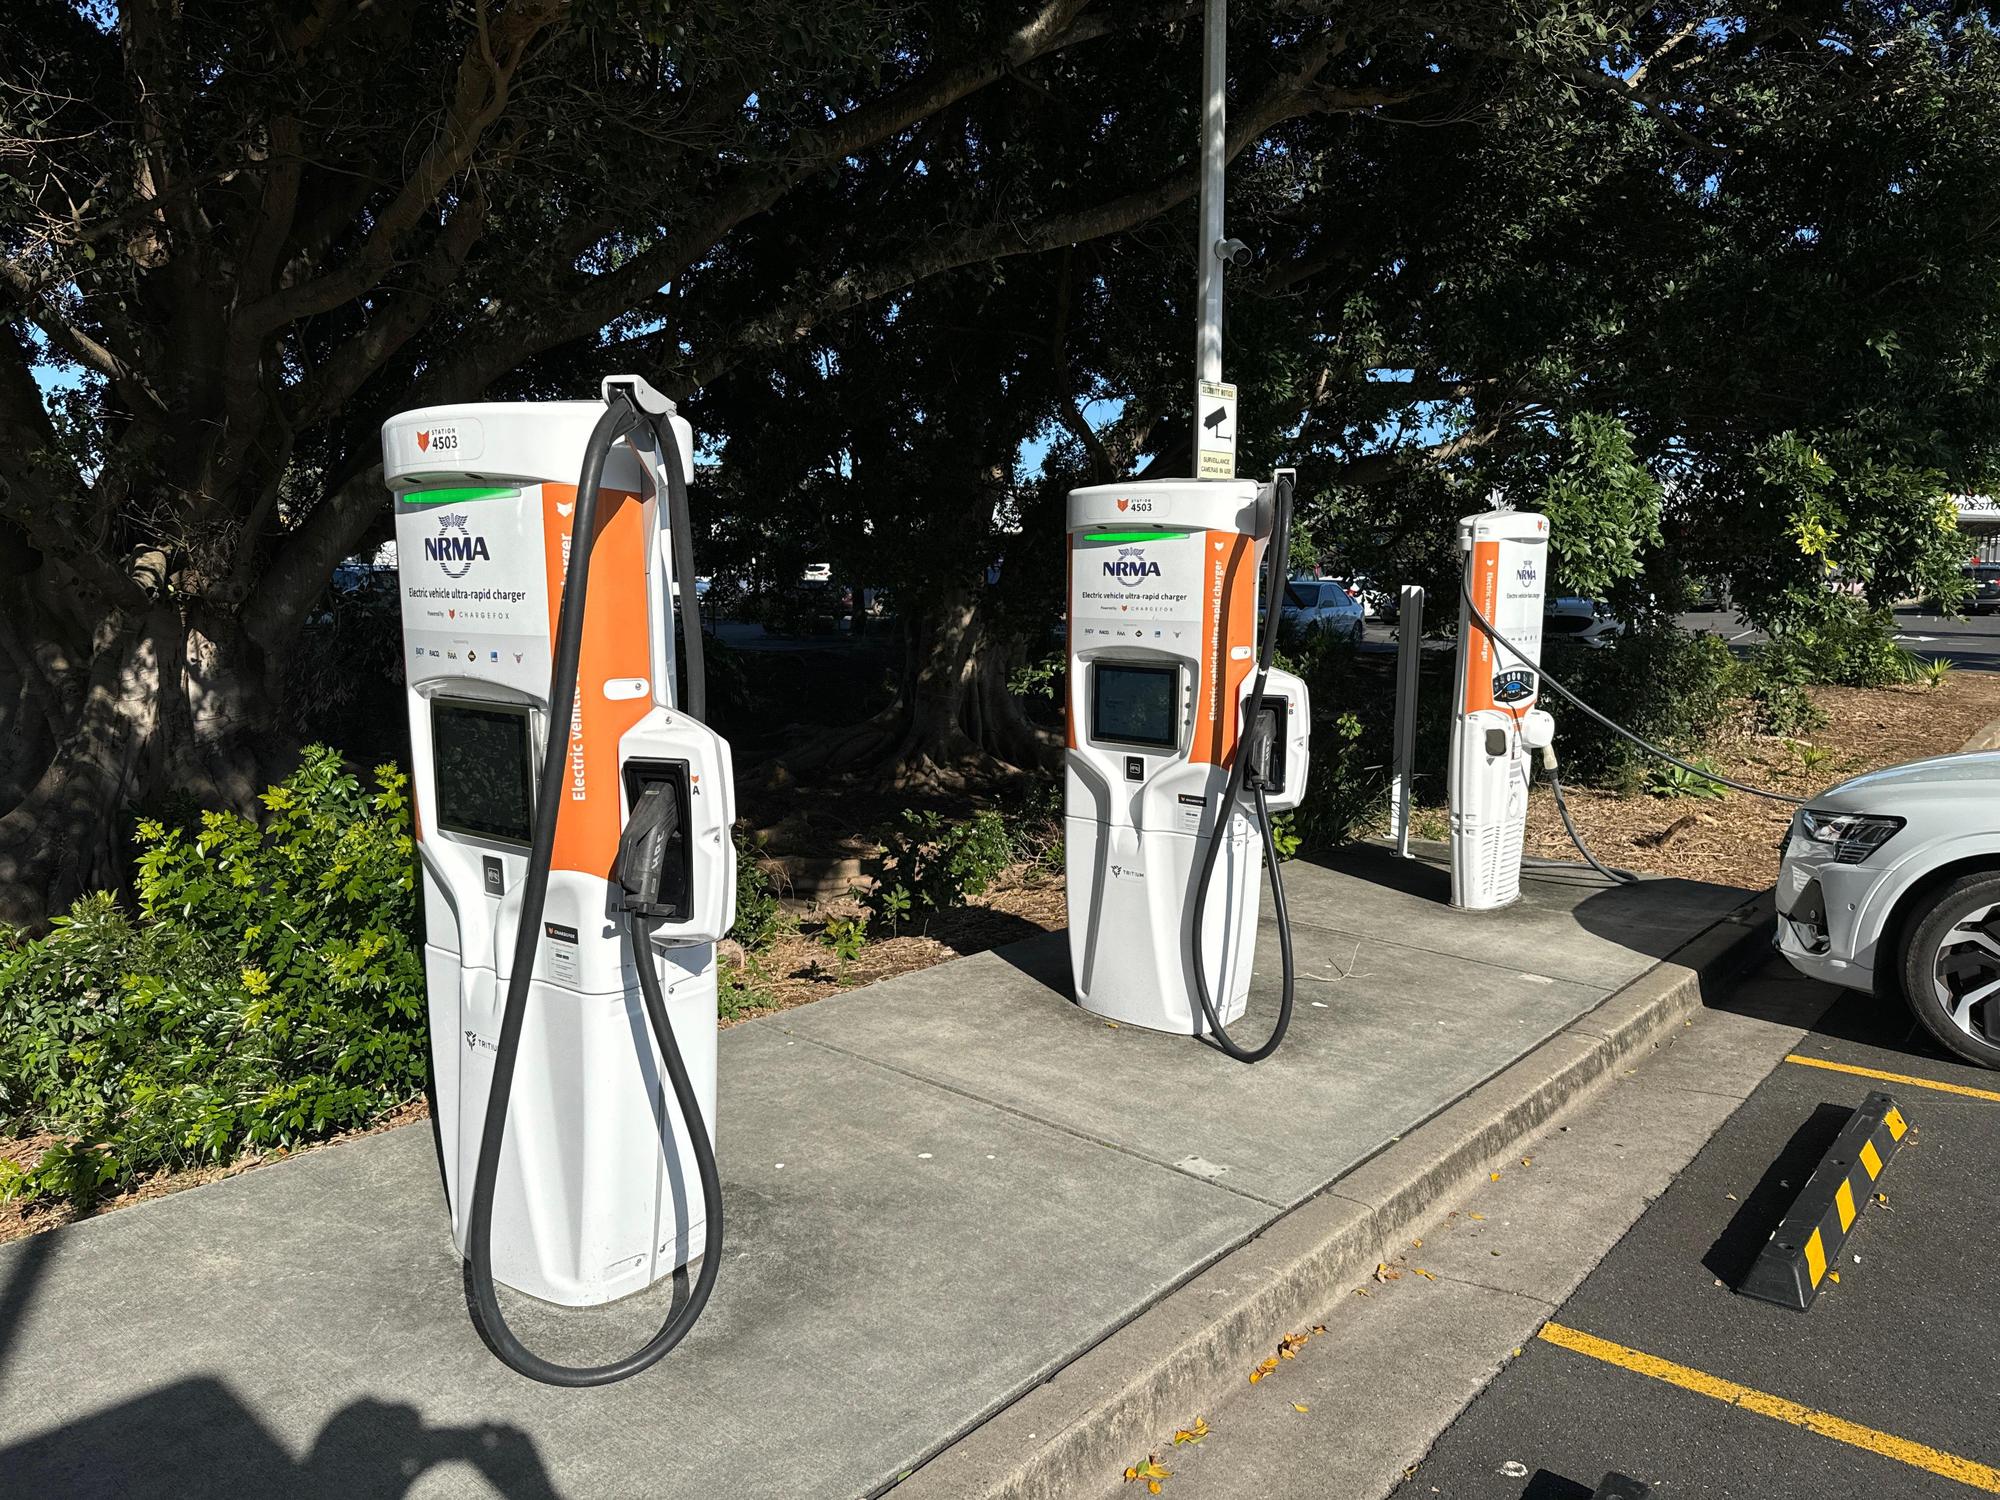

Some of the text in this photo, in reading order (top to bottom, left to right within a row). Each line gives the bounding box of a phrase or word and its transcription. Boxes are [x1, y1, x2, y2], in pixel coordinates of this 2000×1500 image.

[432, 435, 458, 450] 4503
[1203, 456, 1230, 465] SURVEILLANCE
[1131, 503, 1152, 512] 4503
[424, 536, 491, 561] NRMA
[1103, 561, 1162, 577] NRMA
[1516, 569, 1537, 581] NRMA
[408, 587, 526, 603] Electric vehicle ultra-rapid charger
[1082, 591, 1102, 599] Electric
[1125, 592, 1160, 601] ultra-rapid
[1161, 593, 1188, 602] charger
[459, 611, 509, 620] CHARGEFOX
[1209, 560, 1224, 720] Electric vehicle ultra-rapid charger
[570, 743, 586, 800] Electric
[692, 785, 700, 795] A
